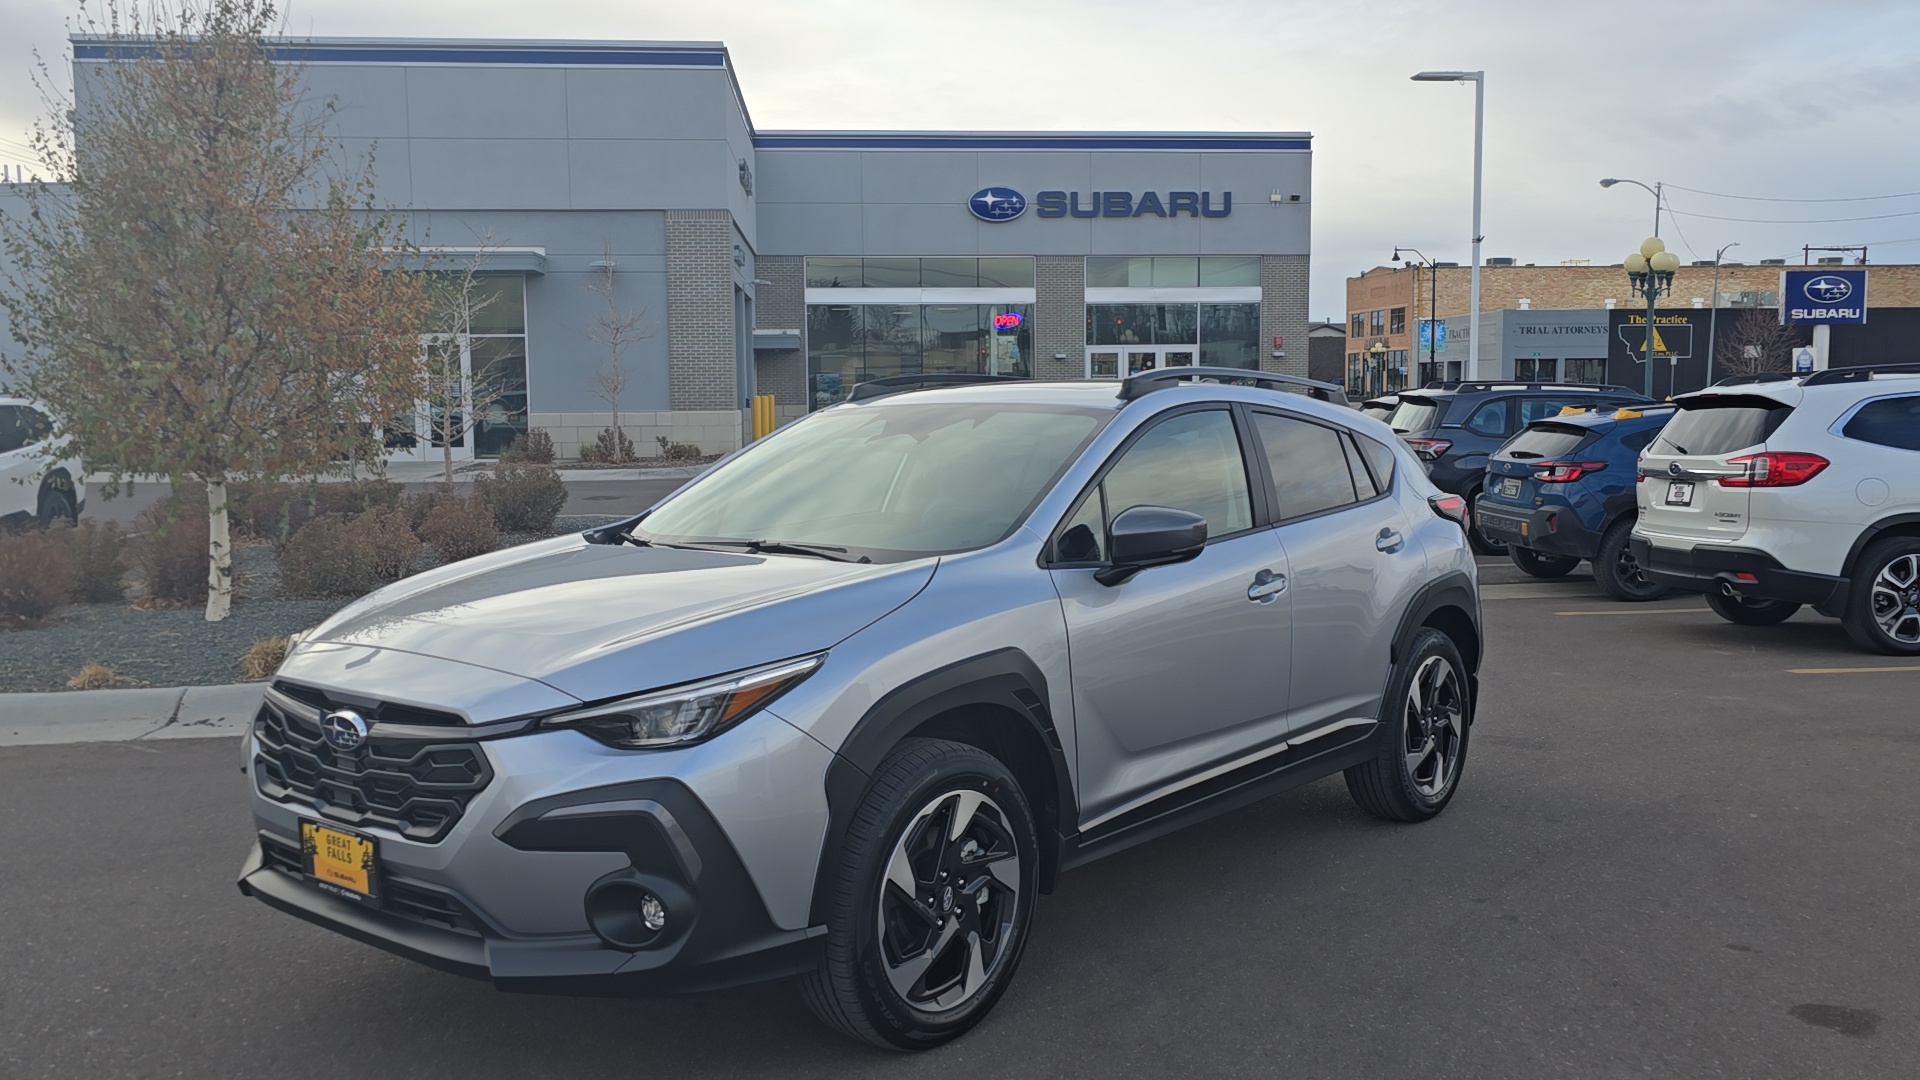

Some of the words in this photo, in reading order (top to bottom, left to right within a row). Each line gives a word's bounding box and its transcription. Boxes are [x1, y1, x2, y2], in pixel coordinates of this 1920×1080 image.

[1036, 191, 1232, 218] SUBARU
[1628, 314, 1647, 324] The
[1791, 308, 1860, 319] SUBARU
[994, 314, 1020, 328] OPEN
[1519, 326, 1549, 335] TRIAL
[1551, 325, 1608, 335] ATTORNEYS
[326, 834, 351, 850] GREAT
[326, 846, 353, 864] FALLS
[333, 871, 357, 884] SUBARU
